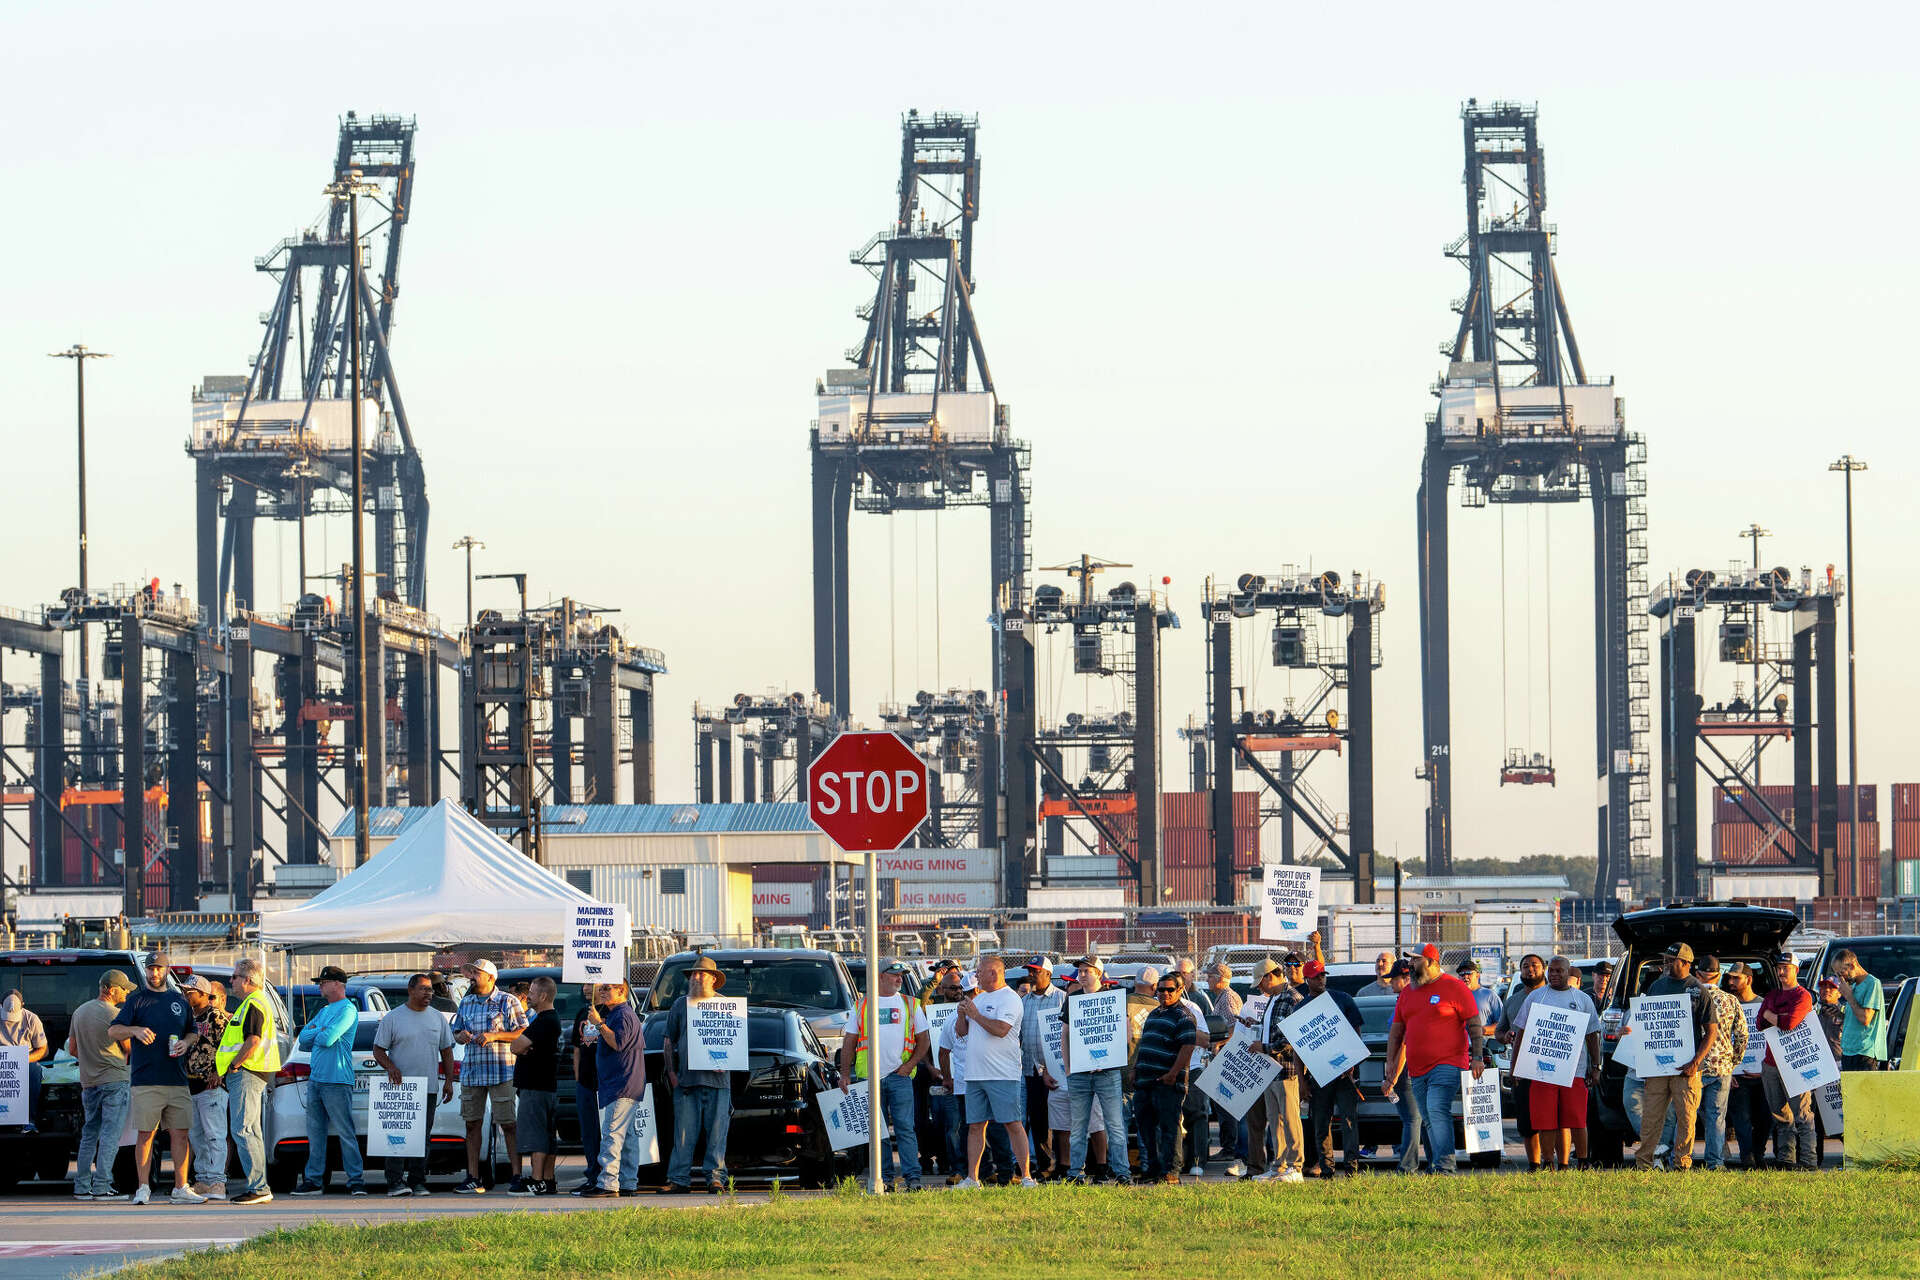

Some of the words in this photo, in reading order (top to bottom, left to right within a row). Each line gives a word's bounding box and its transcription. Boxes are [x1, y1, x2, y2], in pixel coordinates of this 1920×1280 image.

[1432, 745, 1448, 755] 214
[817, 770, 919, 815] STOP
[885, 859, 923, 871] YANG
[928, 859, 967, 871] MING
[1273, 870, 1294, 879] PROFIT
[1295, 871, 1311, 880] OVER
[1277, 880, 1299, 889] PEOPLE
[1300, 881, 1306, 889] IS
[753, 893, 791, 905] MING
[928, 893, 967, 905] MING
[1272, 897, 1298, 906] SUPPORT
[1299, 899, 1309, 907] ILA
[577, 907, 613, 915] MACHINES
[1275, 907, 1304, 916] WORKERS
[576, 918, 595, 926] DON'T
[572, 940, 604, 948] SUPPORT
[605, 941, 616, 949] ILA
[577, 951, 611, 959] WORKERS
[697, 1002, 719, 1010] PROFIT
[720, 1002, 737, 1010] OVER
[1079, 998, 1099, 1008] PROFIT
[1100, 996, 1116, 1006] OVER
[1640, 1000, 1680, 1011] AUTOMATION
[702, 1011, 725, 1019] PEOPLE
[727, 1011, 732, 1019] IS
[1083, 1007, 1105, 1017] PEOPLE
[1106, 1006, 1112, 1014] IS
[1550, 1012, 1568, 1021] FIGHT
[1635, 1012, 1656, 1021] HURTS
[1050, 1021, 1062, 1032] PEOP
[1298, 1025, 1310, 1035] NO
[1308, 1012, 1327, 1029] WORK
[1644, 1022, 1655, 1031] ILA
[1656, 1020, 1680, 1030] STANDS
[698, 1028, 726, 1036] SUPPORT
[727, 1029, 737, 1037] ILA
[1080, 1025, 1106, 1037] SUPPORT
[1107, 1024, 1116, 1033] ILA
[1296, 1027, 1322, 1048] WITHOUT
[1321, 1025, 1328, 1033] A
[1326, 1014, 1342, 1027] FAIR
[1537, 1028, 1554, 1038] SAVE
[1650, 1031, 1662, 1040] FOR
[1663, 1030, 1675, 1039] JOB
[702, 1038, 733, 1046] WORKERS
[1084, 1034, 1113, 1045] WORKERS
[1308, 1027, 1339, 1052] CONTRACT
[1780, 1033, 1796, 1046] DON'T
[1796, 1028, 1811, 1039] FEED
[1531, 1036, 1541, 1046] ILA
[1541, 1038, 1573, 1052] DEMANDS
[1645, 1039, 1683, 1050] PROTECTION
[1528, 1045, 1540, 1054] JOB
[1540, 1048, 1572, 1060] SECURITY
[1784, 1049, 1810, 1063] SUPPORT
[1809, 1044, 1820, 1054] ILA
[1236, 1049, 1257, 1070] PEOPLE
[1254, 1065, 1262, 1074] IS
[1256, 1055, 1271, 1070] OVER
[1791, 1053, 1819, 1069] WORKERS
[1222, 1060, 1247, 1083] SUPPORT
[1244, 1077, 1255, 1089] ILA
[1220, 1069, 1247, 1093] WORKERS
[401, 1083, 417, 1091] OVER
[1486, 1084, 1496, 1093] OVER
[0, 1089, 20, 1098] CURITY
[384, 1092, 405, 1100] PEOPLE
[407, 1092, 413, 1100] IS
[378, 1111, 405, 1120] SUPPORT
[845, 1095, 858, 1124] SUPPORT
[853, 1123, 861, 1135] ILA
[1470, 1105, 1485, 1115] DEFEND
[1486, 1105, 1494, 1113] OUR
[839, 1101, 853, 1132] WORKERS
[1476, 1115, 1485, 1124] AND
[1485, 1114, 1499, 1123] RIGHTS
[382, 1121, 412, 1129] WORKERS
